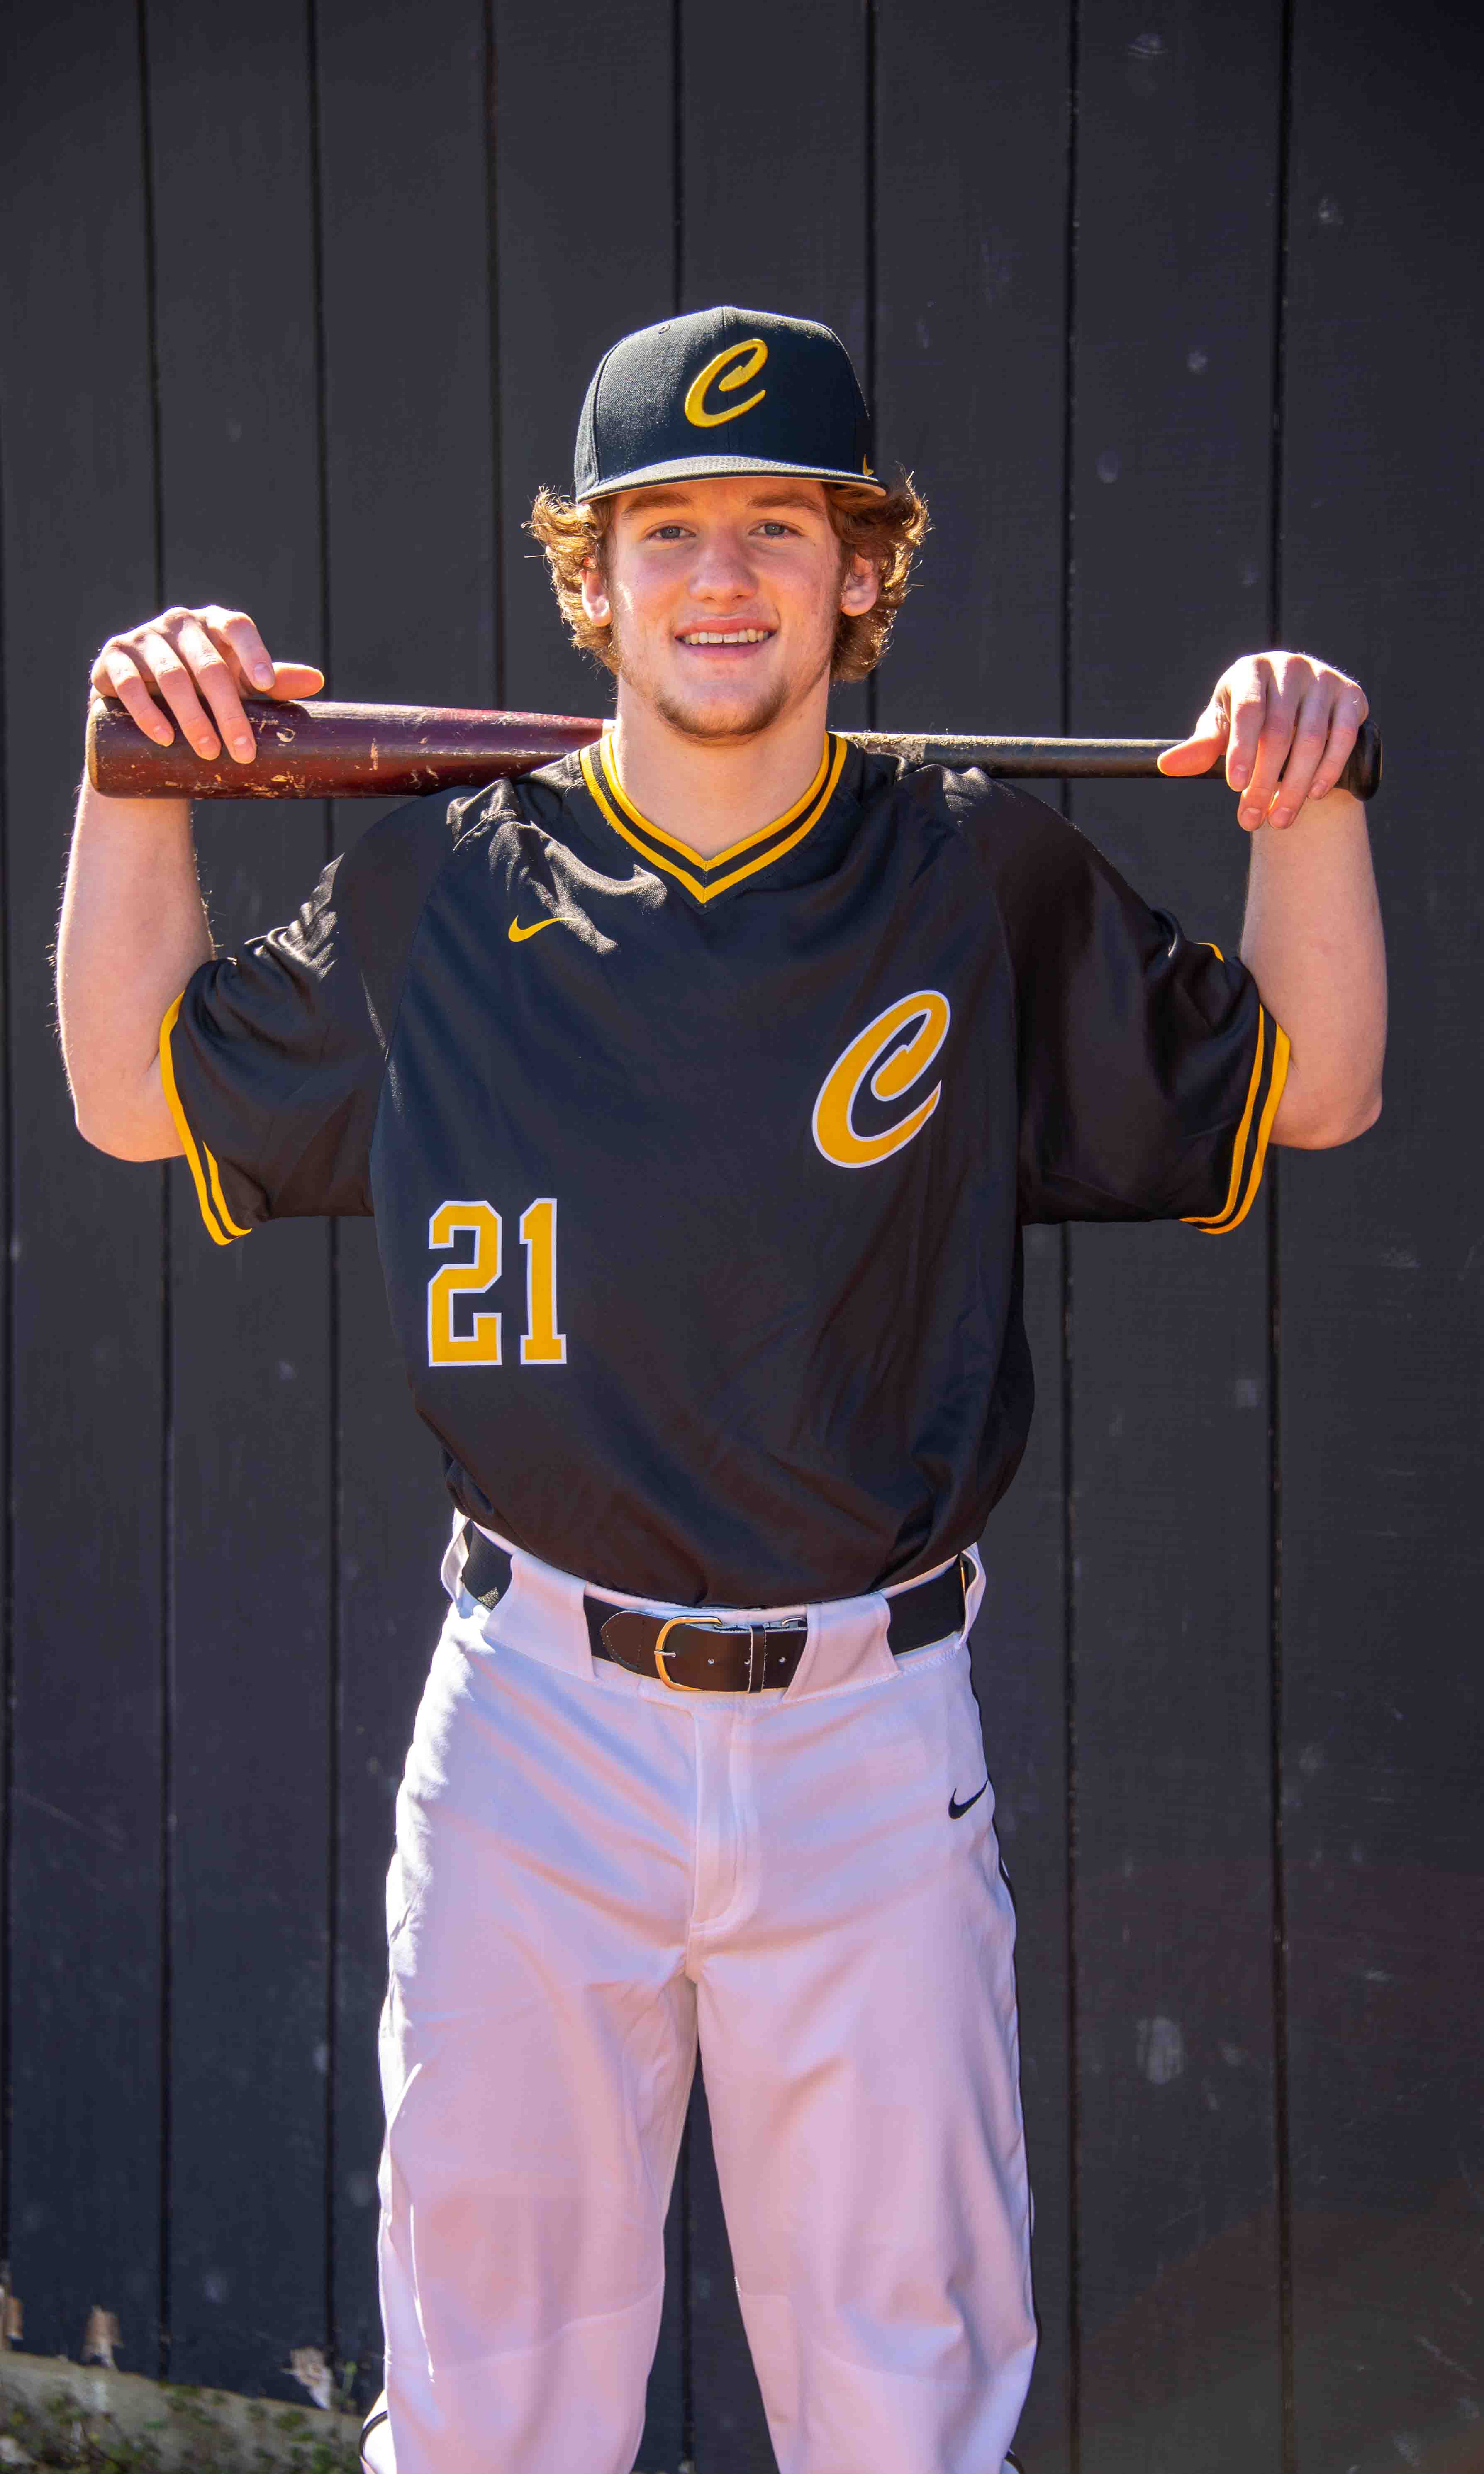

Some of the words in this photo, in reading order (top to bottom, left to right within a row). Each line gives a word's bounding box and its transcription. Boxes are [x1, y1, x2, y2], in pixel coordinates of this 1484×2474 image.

[685, 339, 768, 427] C
[812, 990, 950, 1168] C
[428, 1198, 567, 1367] 21
